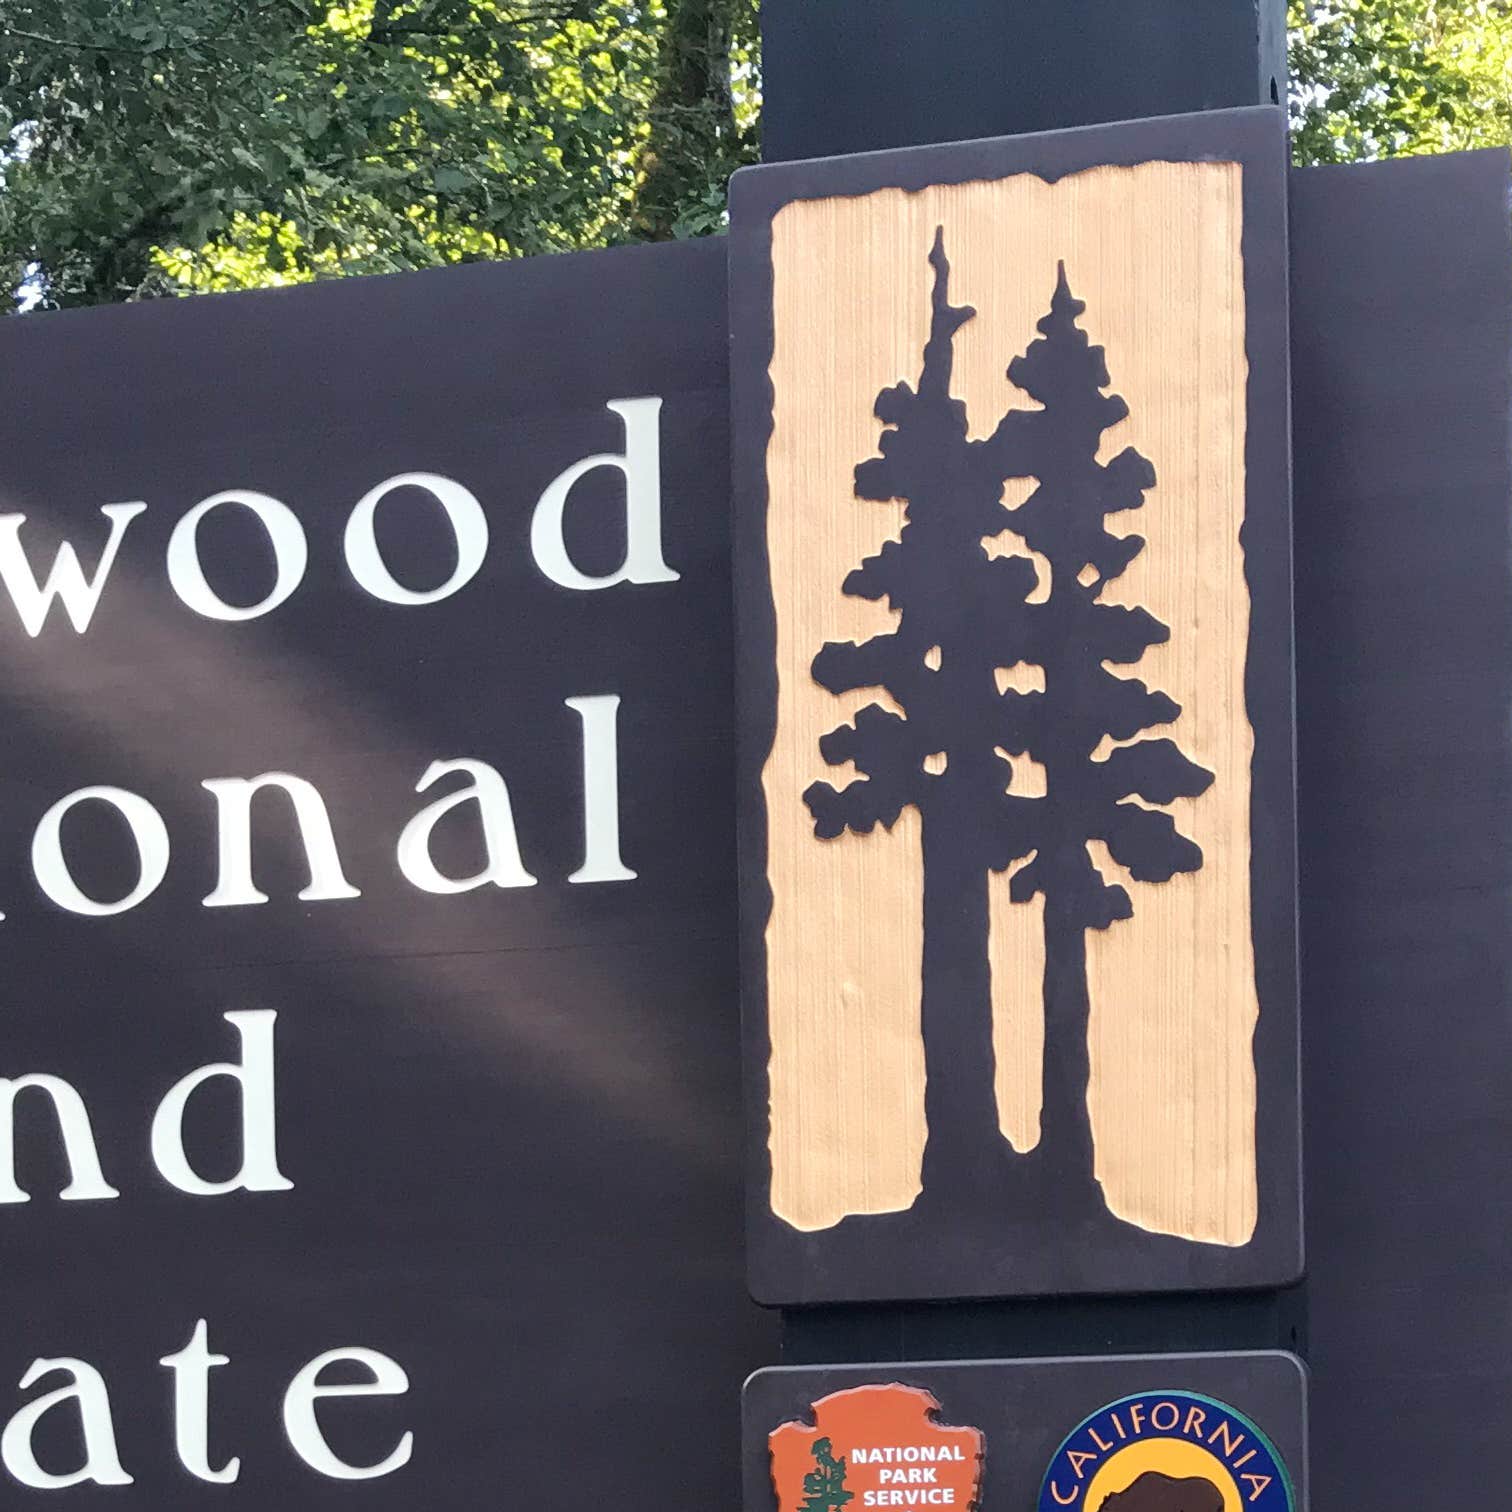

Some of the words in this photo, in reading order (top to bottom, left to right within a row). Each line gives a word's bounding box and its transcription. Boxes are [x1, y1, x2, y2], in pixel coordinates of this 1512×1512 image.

[0, 396, 681, 637] wood
[0, 694, 639, 920] onal
[0, 1009, 295, 1203] nd
[0, 1318, 414, 1489] ate
[851, 1445, 966, 1465] NATIONAL
[1051, 1402, 1272, 1505] CALIFORNIA
[863, 1488, 956, 1507] SERVICE
[879, 1467, 938, 1484] PARK
